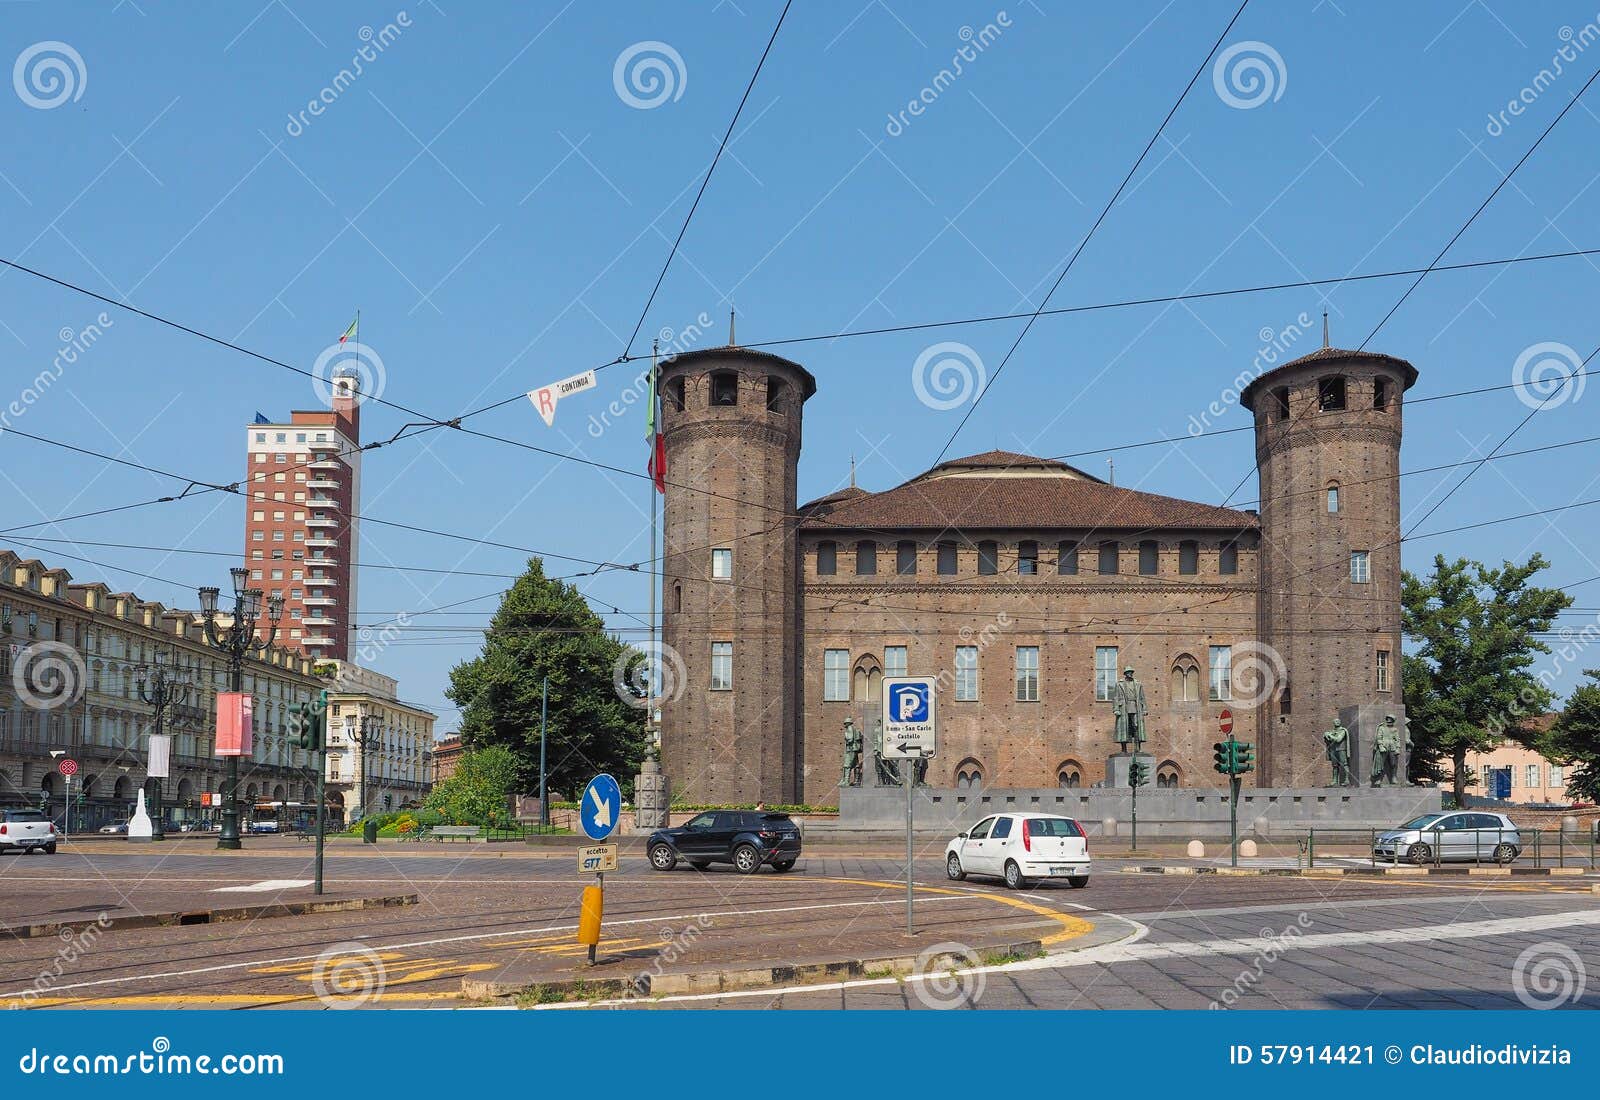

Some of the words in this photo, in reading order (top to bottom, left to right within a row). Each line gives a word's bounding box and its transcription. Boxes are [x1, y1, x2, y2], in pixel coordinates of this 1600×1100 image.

[538, 388, 554, 416] R
[561, 376, 589, 393] CONTINUA
[899, 693, 920, 720] P
[586, 847, 608, 855] eccetto
